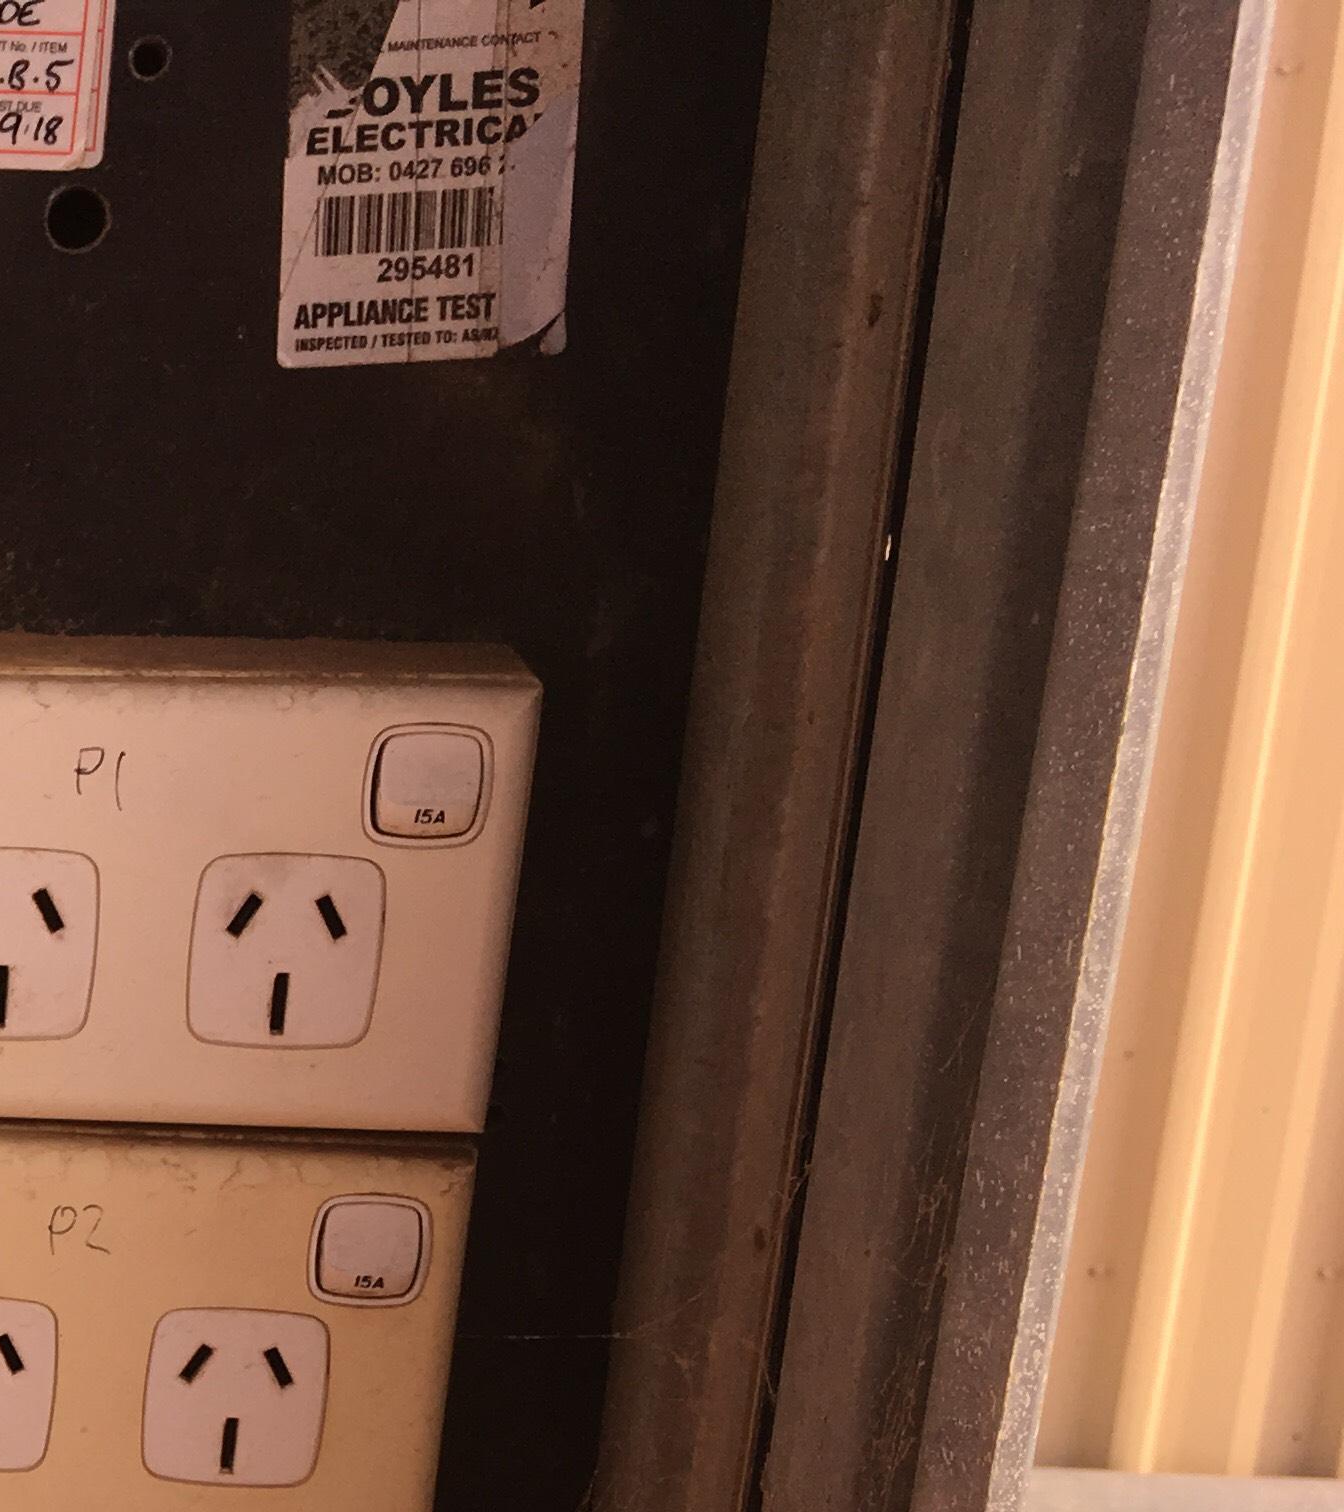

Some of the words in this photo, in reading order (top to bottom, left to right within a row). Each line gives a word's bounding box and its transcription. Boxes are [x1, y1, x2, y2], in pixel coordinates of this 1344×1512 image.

[39, 41, 68, 54] ITEM
[388, 34, 478, 52] MAINTENANCE
[481, 31, 542, 47] CONTACT
[16, 101, 42, 113] DUE
[326, 66, 540, 119] OYLES
[305, 112, 544, 155] ELECTRICA
[317, 162, 381, 185] MOB:
[389, 159, 444, 181] 0427
[450, 156, 491, 177] 696
[376, 253, 475, 283] 295481
[293, 296, 429, 330] APPLIANCE
[436, 293, 497, 321] TEST
[295, 335, 368, 352] INSPECTED
[381, 331, 431, 348] TESTED
[435, 330, 458, 344] TO:
[72, 745, 127, 812] P1
[413, 808, 446, 825] 15A
[47, 1202, 111, 1256] P2
[354, 1275, 385, 1291] 15A
